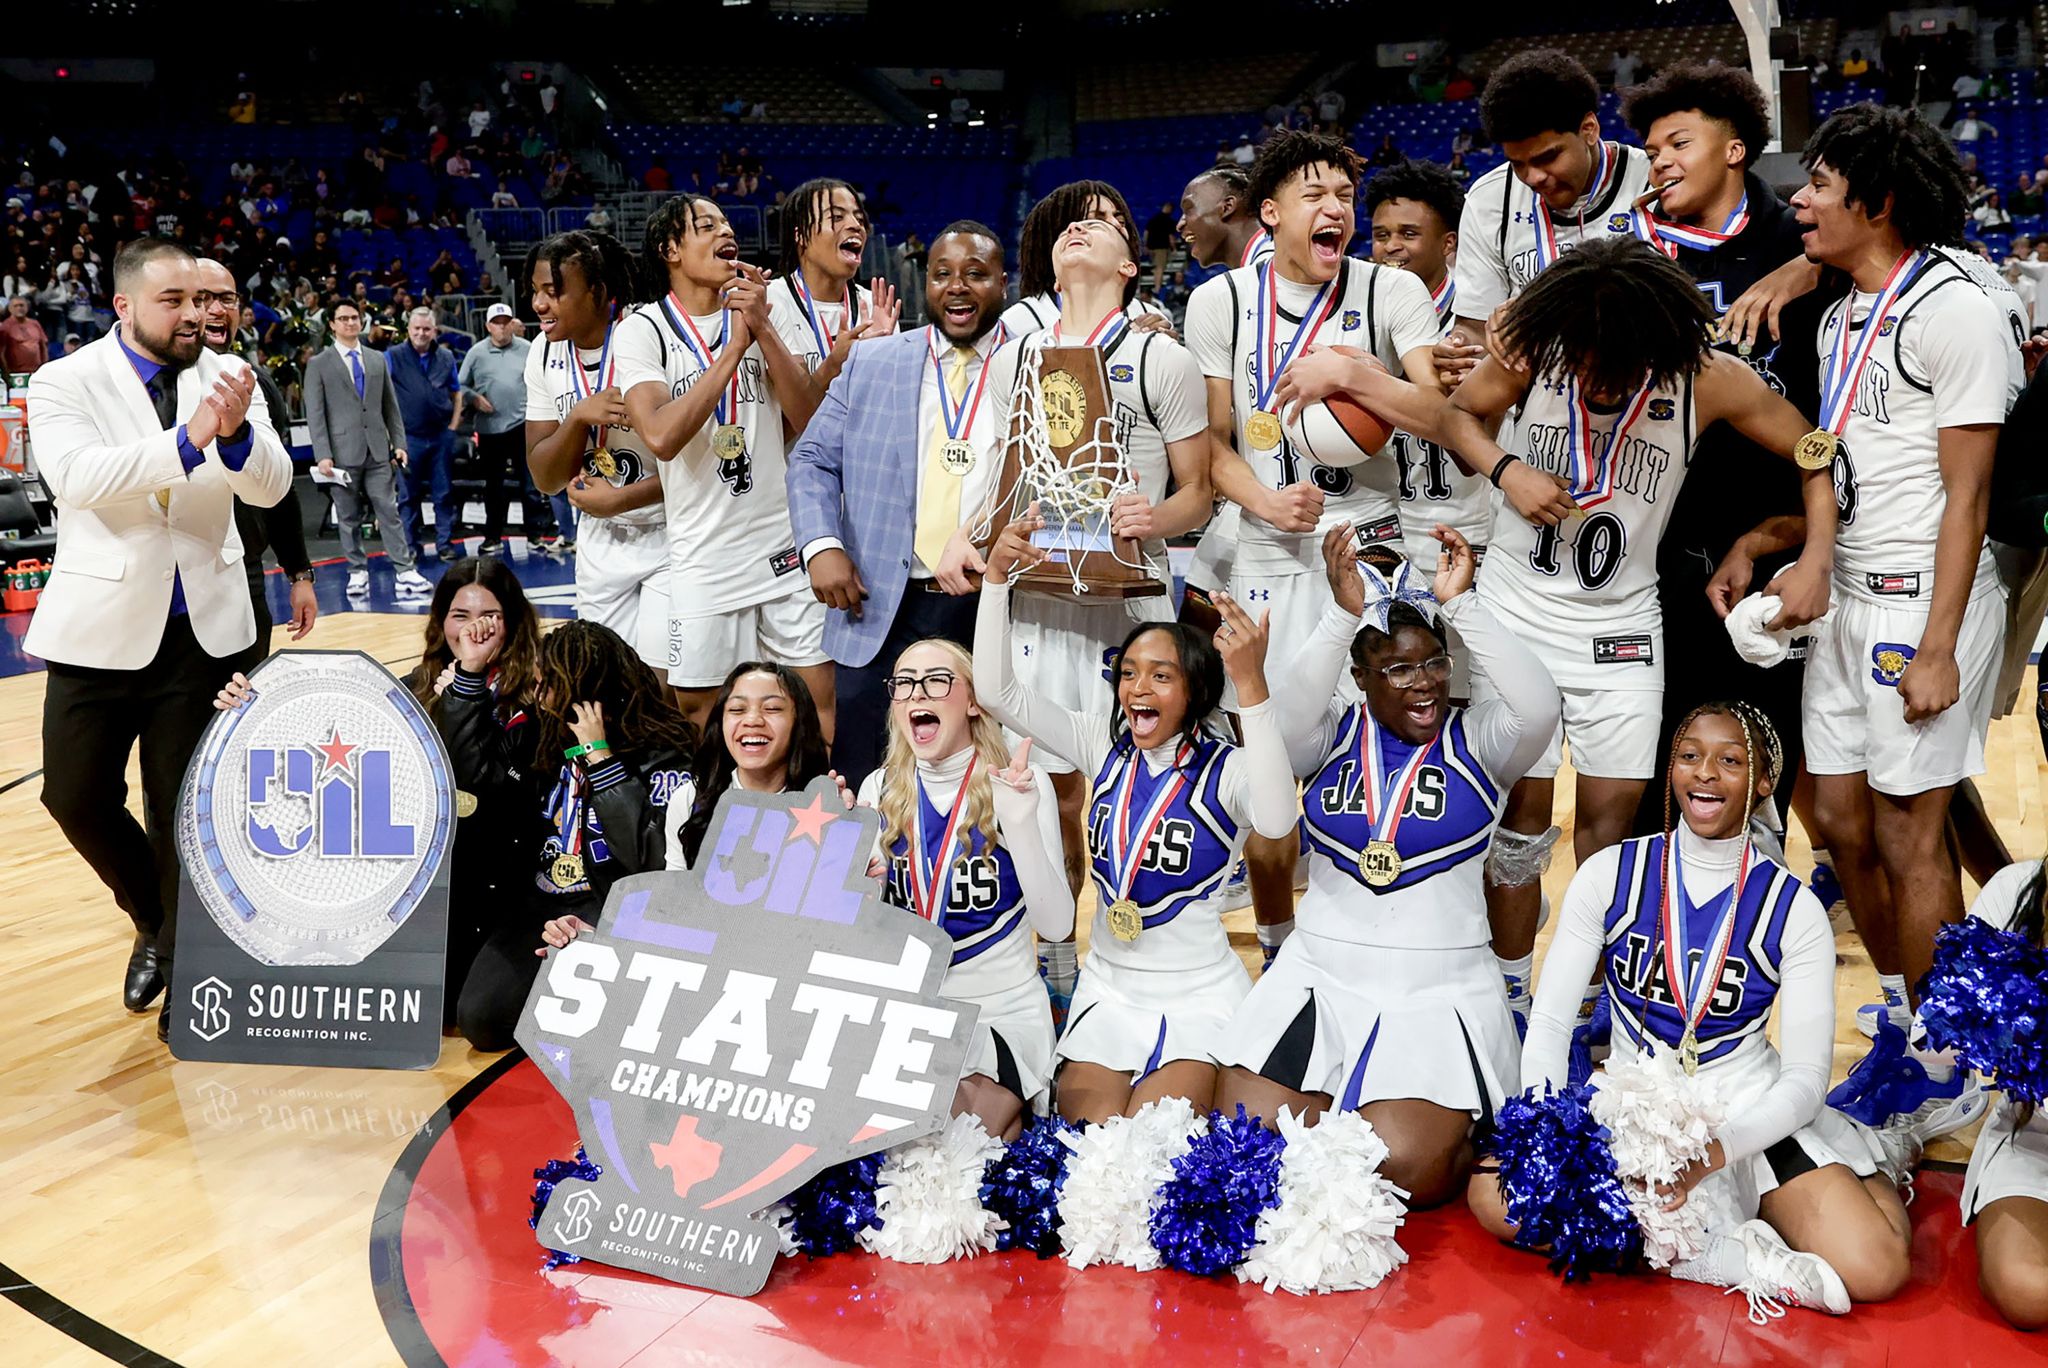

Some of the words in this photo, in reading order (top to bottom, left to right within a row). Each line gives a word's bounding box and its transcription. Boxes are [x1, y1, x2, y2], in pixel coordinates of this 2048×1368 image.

[716, 427, 753, 497] 4
[946, 448, 969, 464] UIL
[1529, 511, 1627, 590] 10
[246, 742, 418, 859] UIL
[557, 863, 577, 879] UIL
[703, 800, 865, 926] UIL
[1088, 803, 1196, 876] JGS
[1366, 852, 1393, 871] UIL
[887, 856, 1000, 913] JGS
[246, 1027, 339, 1041] RECOGNITION
[343, 1031, 372, 1042] INC.
[247, 983, 421, 1023] SOUTHERN
[533, 939, 960, 1112] STATE
[609, 1058, 816, 1132] CHAMPIONS
[600, 1239, 680, 1267] RECOGNITION
[682, 1260, 707, 1274] INC.
[608, 1202, 763, 1266] SOUTHERN
